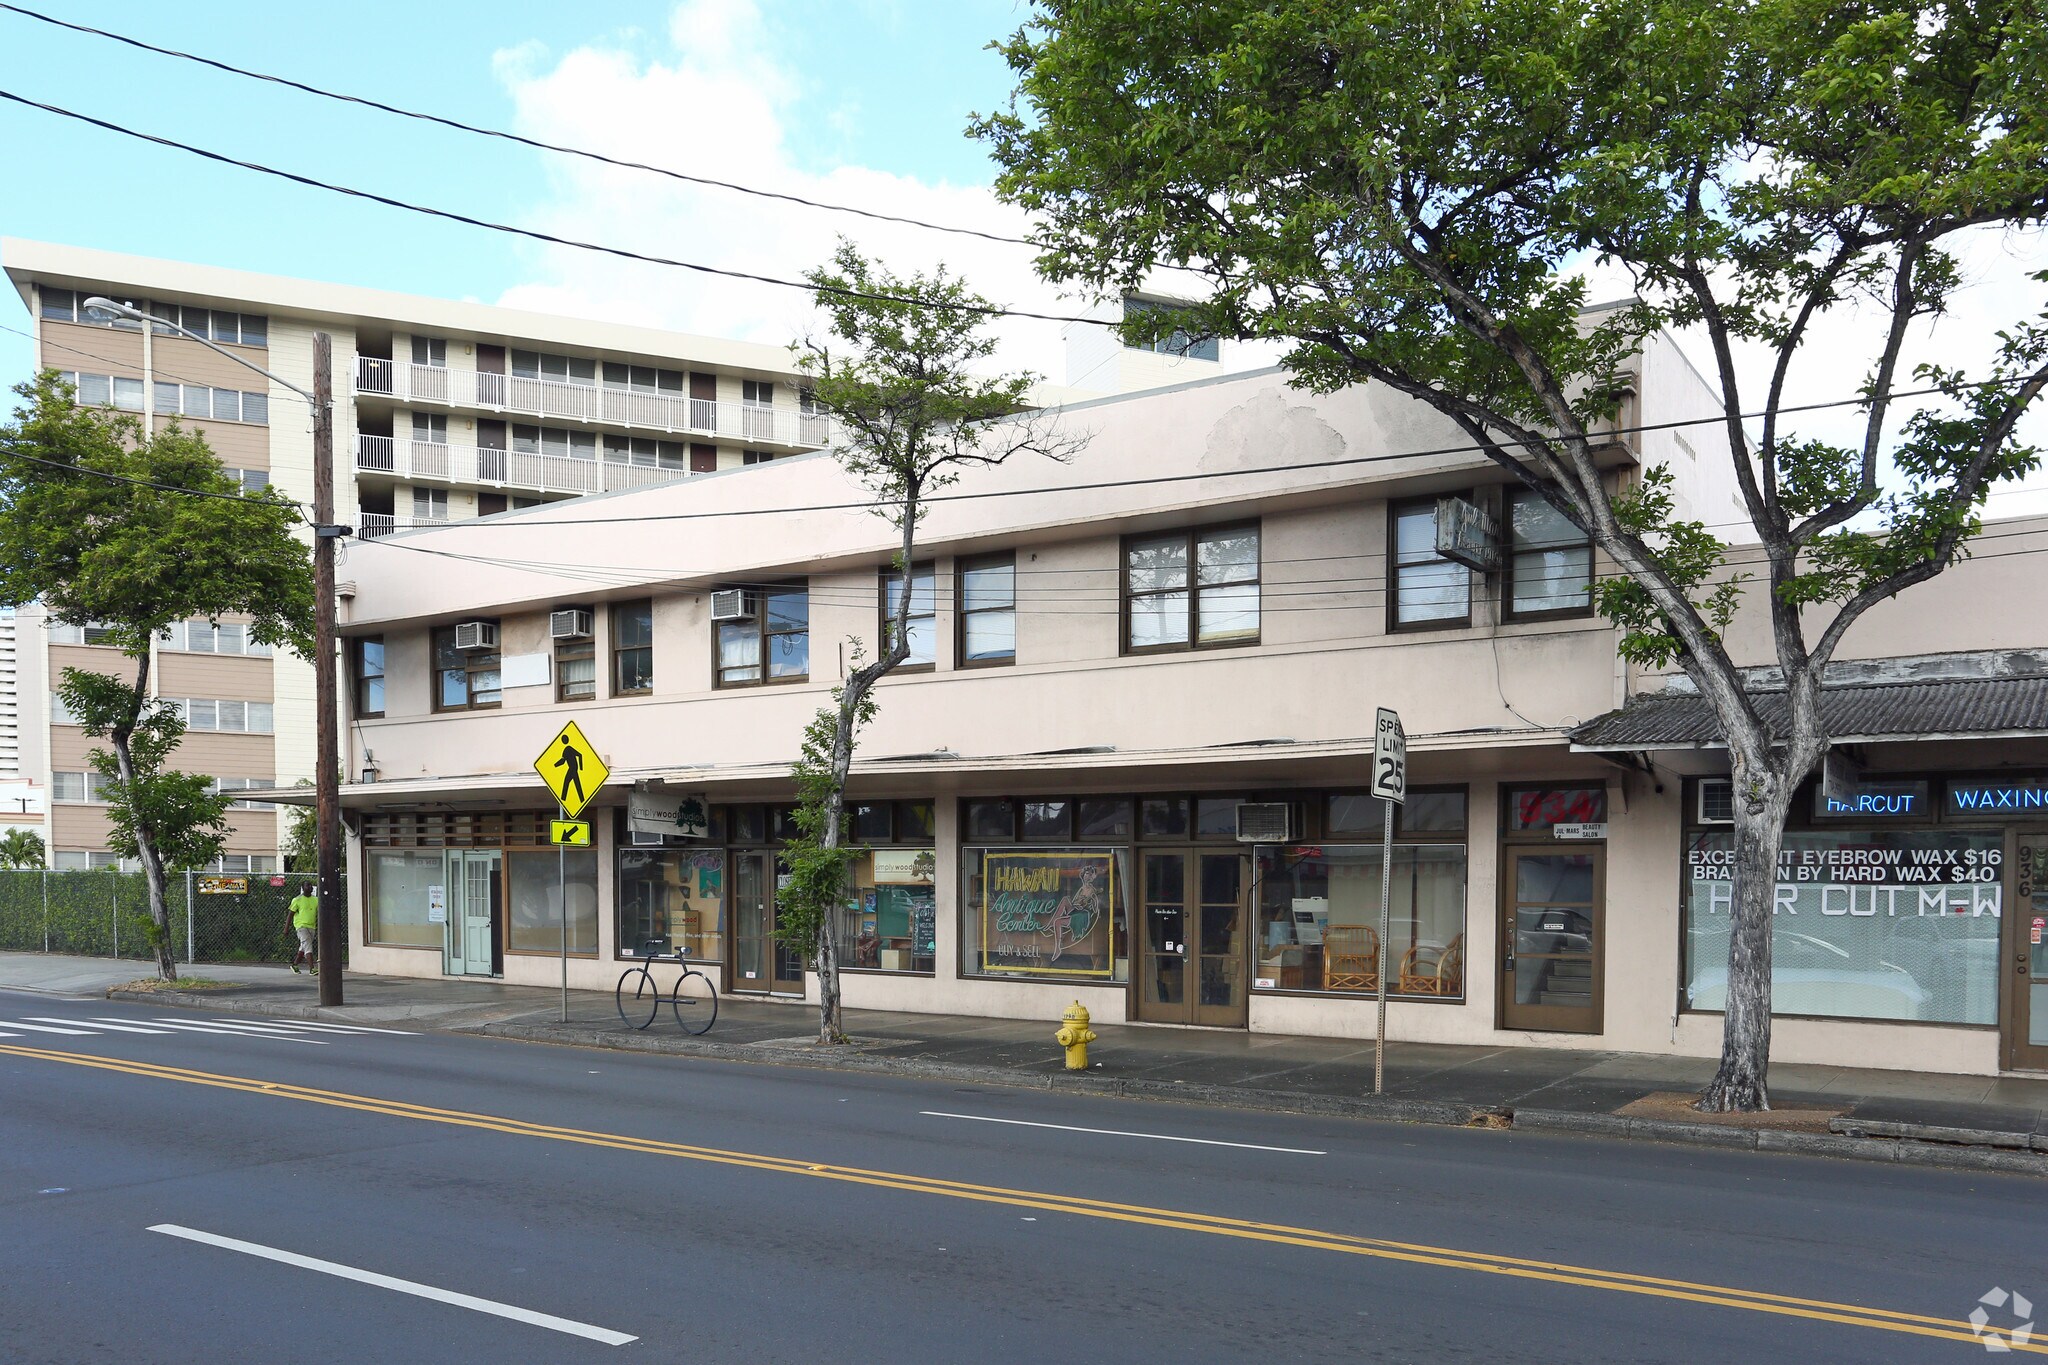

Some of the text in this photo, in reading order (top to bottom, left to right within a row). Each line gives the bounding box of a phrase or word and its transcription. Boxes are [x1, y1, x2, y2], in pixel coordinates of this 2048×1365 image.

[1378, 757, 1403, 793] 25
[1955, 789, 2048, 808] WAXIN
[1688, 848, 2001, 866] EXCET EYEBROW WAX $16
[995, 866, 1059, 892] HAWAII
[1797, 866, 1822, 881] BY
[1831, 866, 1887, 881] HARD
[1895, 866, 1942, 882] WAX
[1951, 866, 1995, 883] $40
[2018, 846, 2031, 897] 936
[1709, 884, 1798, 915] HR
[1821, 885, 1905, 916] CUT
[996, 912, 1043, 932] Center
[998, 945, 1013, 957] BUY
[1022, 945, 1041, 958] SELL
